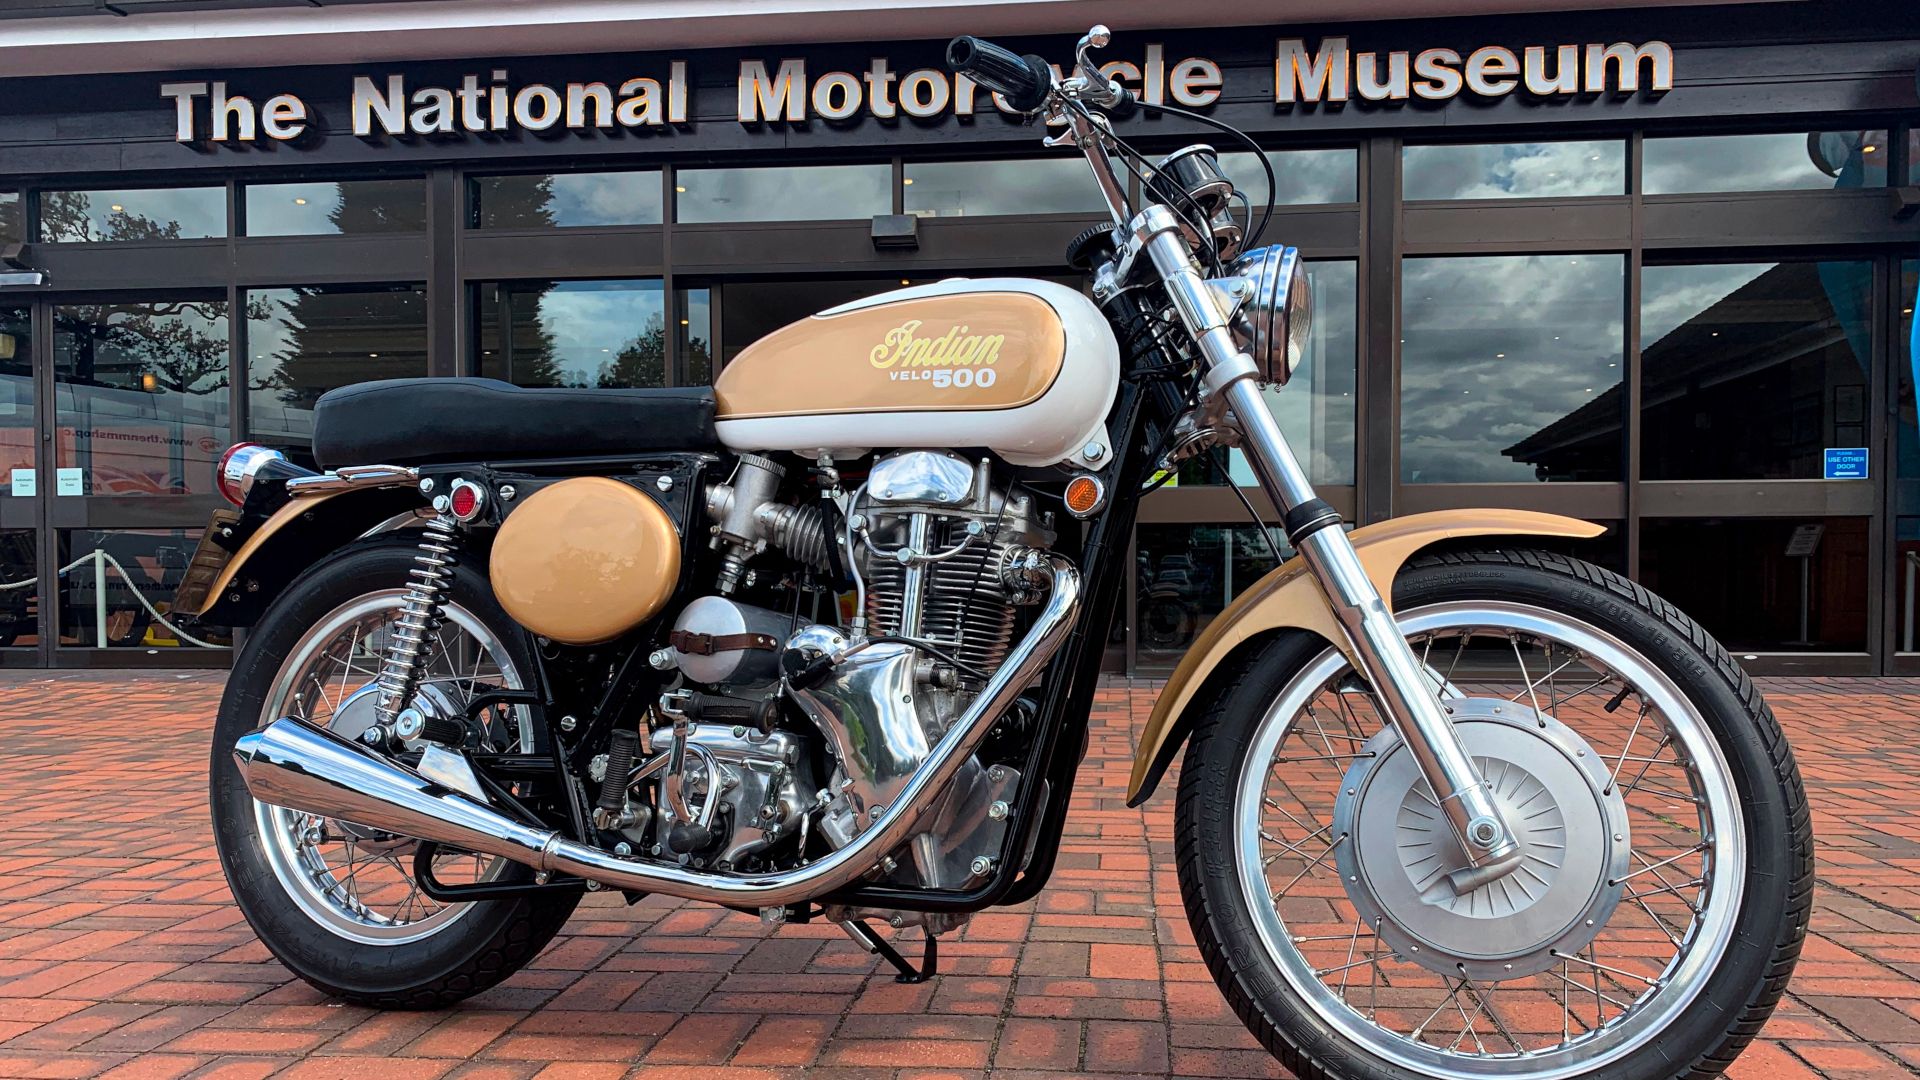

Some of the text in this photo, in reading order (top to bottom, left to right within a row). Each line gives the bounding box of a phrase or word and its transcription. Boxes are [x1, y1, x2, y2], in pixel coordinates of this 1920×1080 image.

[160, 35, 1674, 142] The National Motorcle Museum
[870, 319, 1005, 369] Indian
[889, 368, 997, 388] VELO 500
